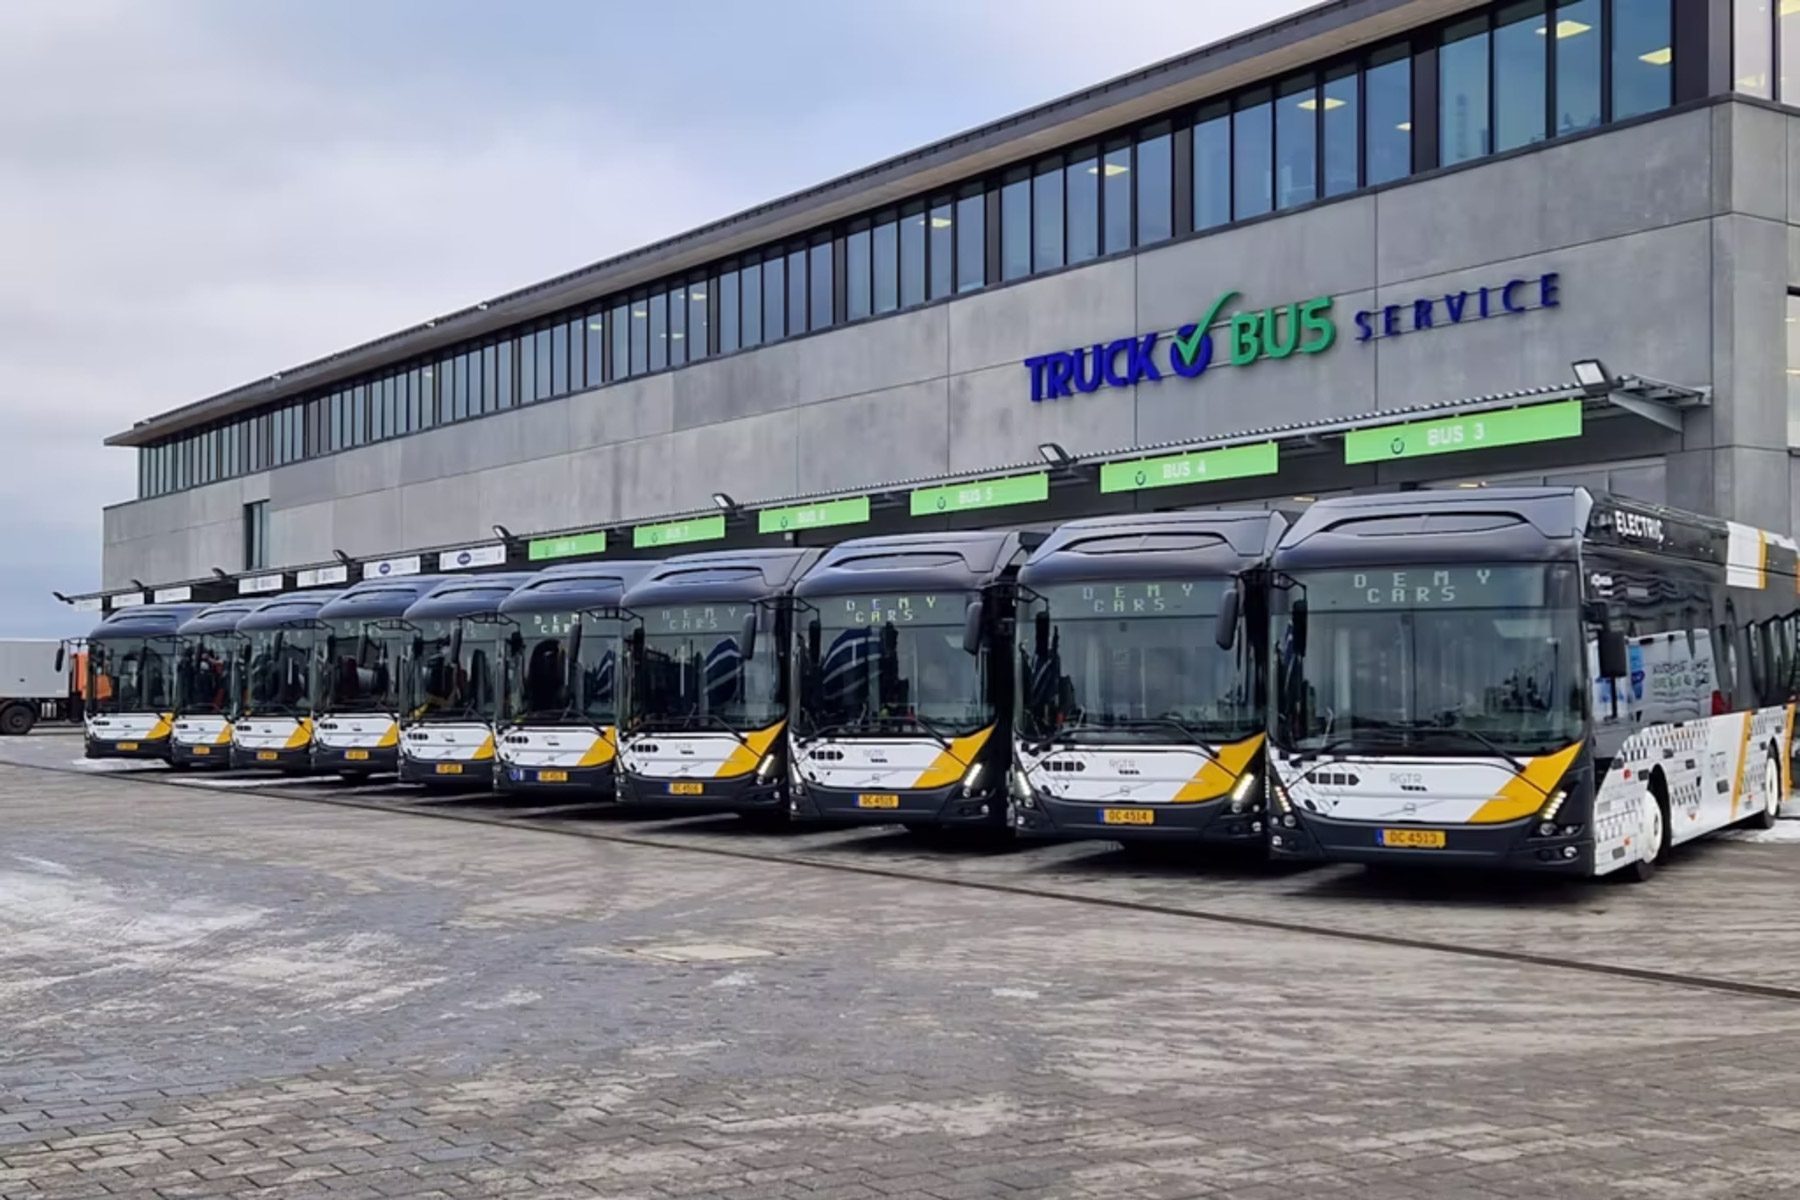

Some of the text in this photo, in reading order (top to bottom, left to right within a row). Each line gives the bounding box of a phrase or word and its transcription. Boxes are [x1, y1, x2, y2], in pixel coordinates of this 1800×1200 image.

[1025, 272, 1560, 402] TRUCK BUS SERVICE
[1427, 422, 1485, 447] BUS 3
[1162, 461, 1191, 479] BUS
[1353, 568, 1491, 588] DEMY
[1082, 582, 1194, 600] DEMY
[1366, 586, 1456, 604] CARS
[846, 595, 936, 611] DEMY
[1094, 597, 1166, 613] CARS
[855, 608, 914, 623] CARS
